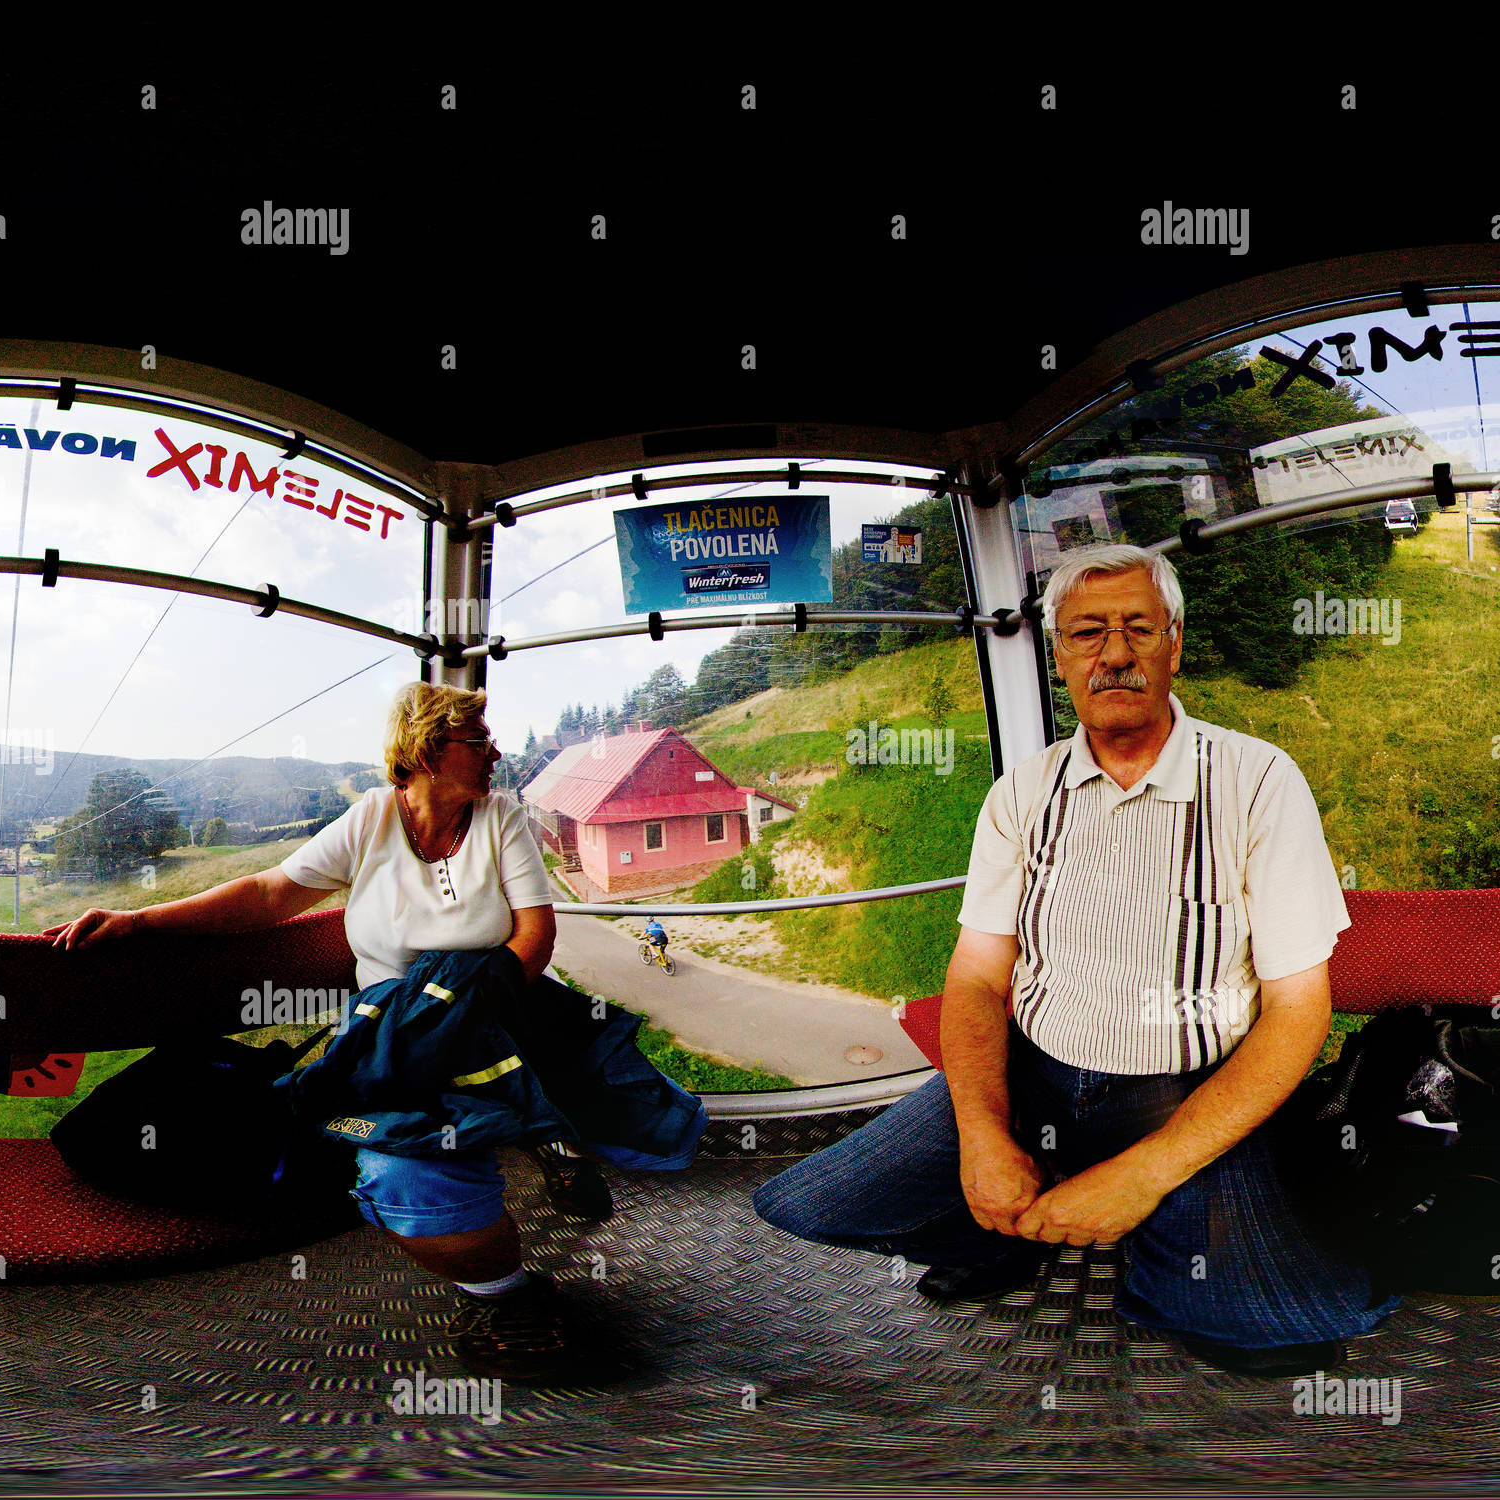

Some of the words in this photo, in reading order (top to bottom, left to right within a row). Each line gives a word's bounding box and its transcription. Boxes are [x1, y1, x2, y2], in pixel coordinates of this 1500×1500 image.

[663, 504, 780, 533] TLAČENICA
[670, 523, 779, 561] POVOLENÁ
[688, 573, 765, 589] Winterfresh
[686, 597, 700, 605] PRE
[700, 593, 738, 603] MAXIMÁLNU
